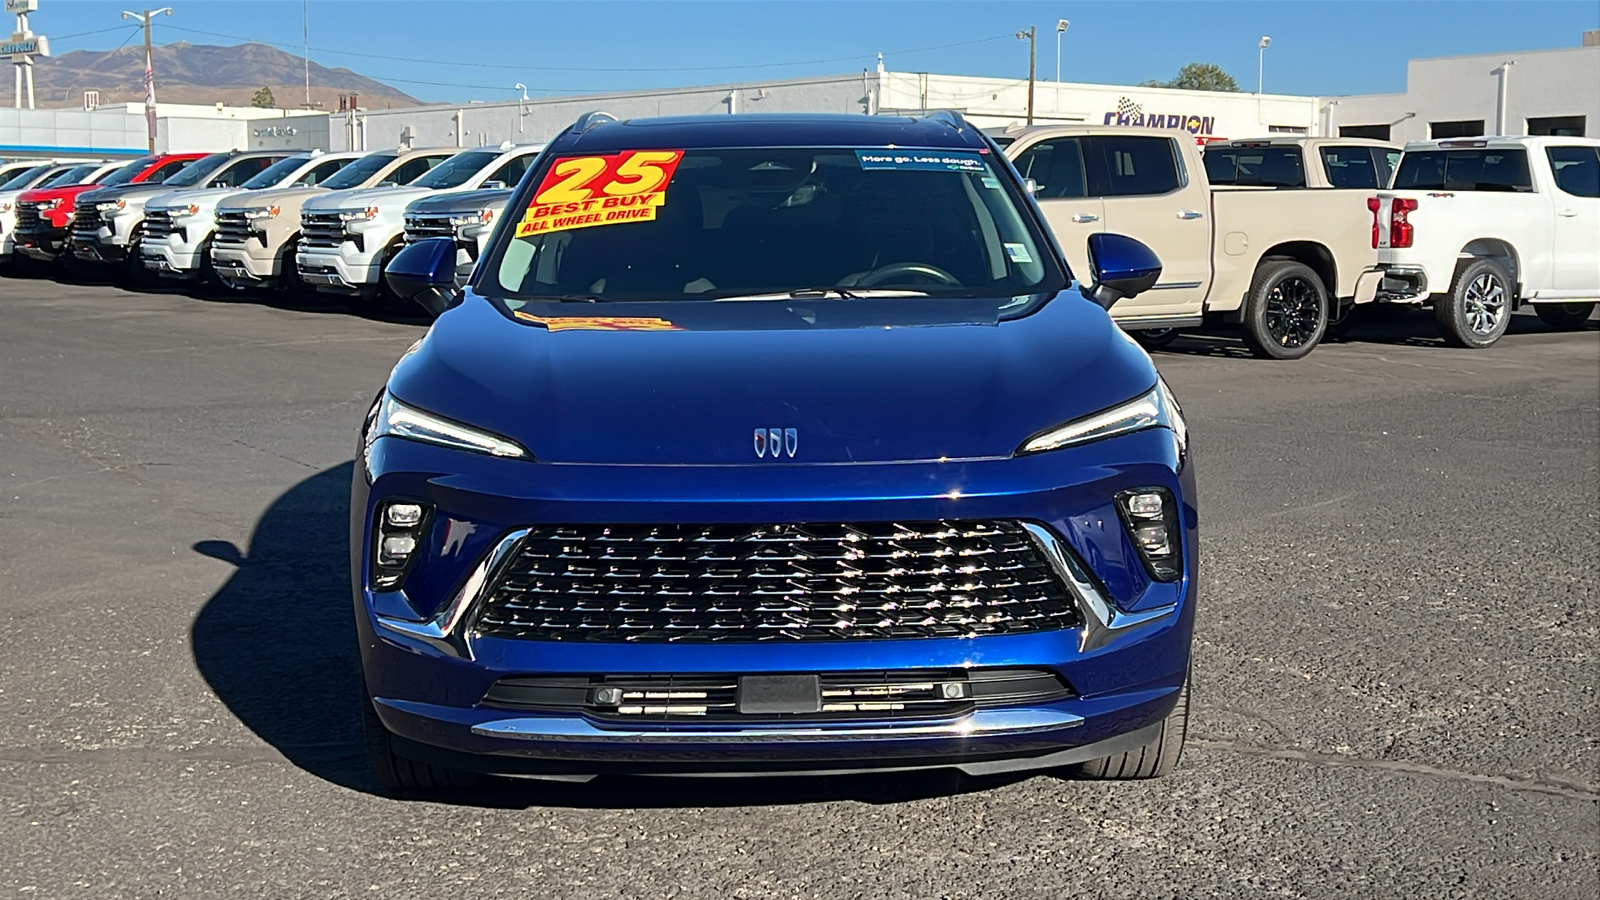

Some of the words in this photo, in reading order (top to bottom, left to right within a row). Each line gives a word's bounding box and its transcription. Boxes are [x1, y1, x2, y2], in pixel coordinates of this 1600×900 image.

[1104, 112, 1215, 135] CHAMPION
[861, 155, 893, 163] More
[894, 156, 913, 164] go.
[941, 157, 982, 166] dough.
[536, 152, 679, 204] 25
[533, 200, 596, 218] BEST
[602, 194, 657, 209] BUY
[521, 220, 549, 234] ALL
[552, 213, 603, 228] WHEEL
[606, 208, 652, 221] DRIVE
